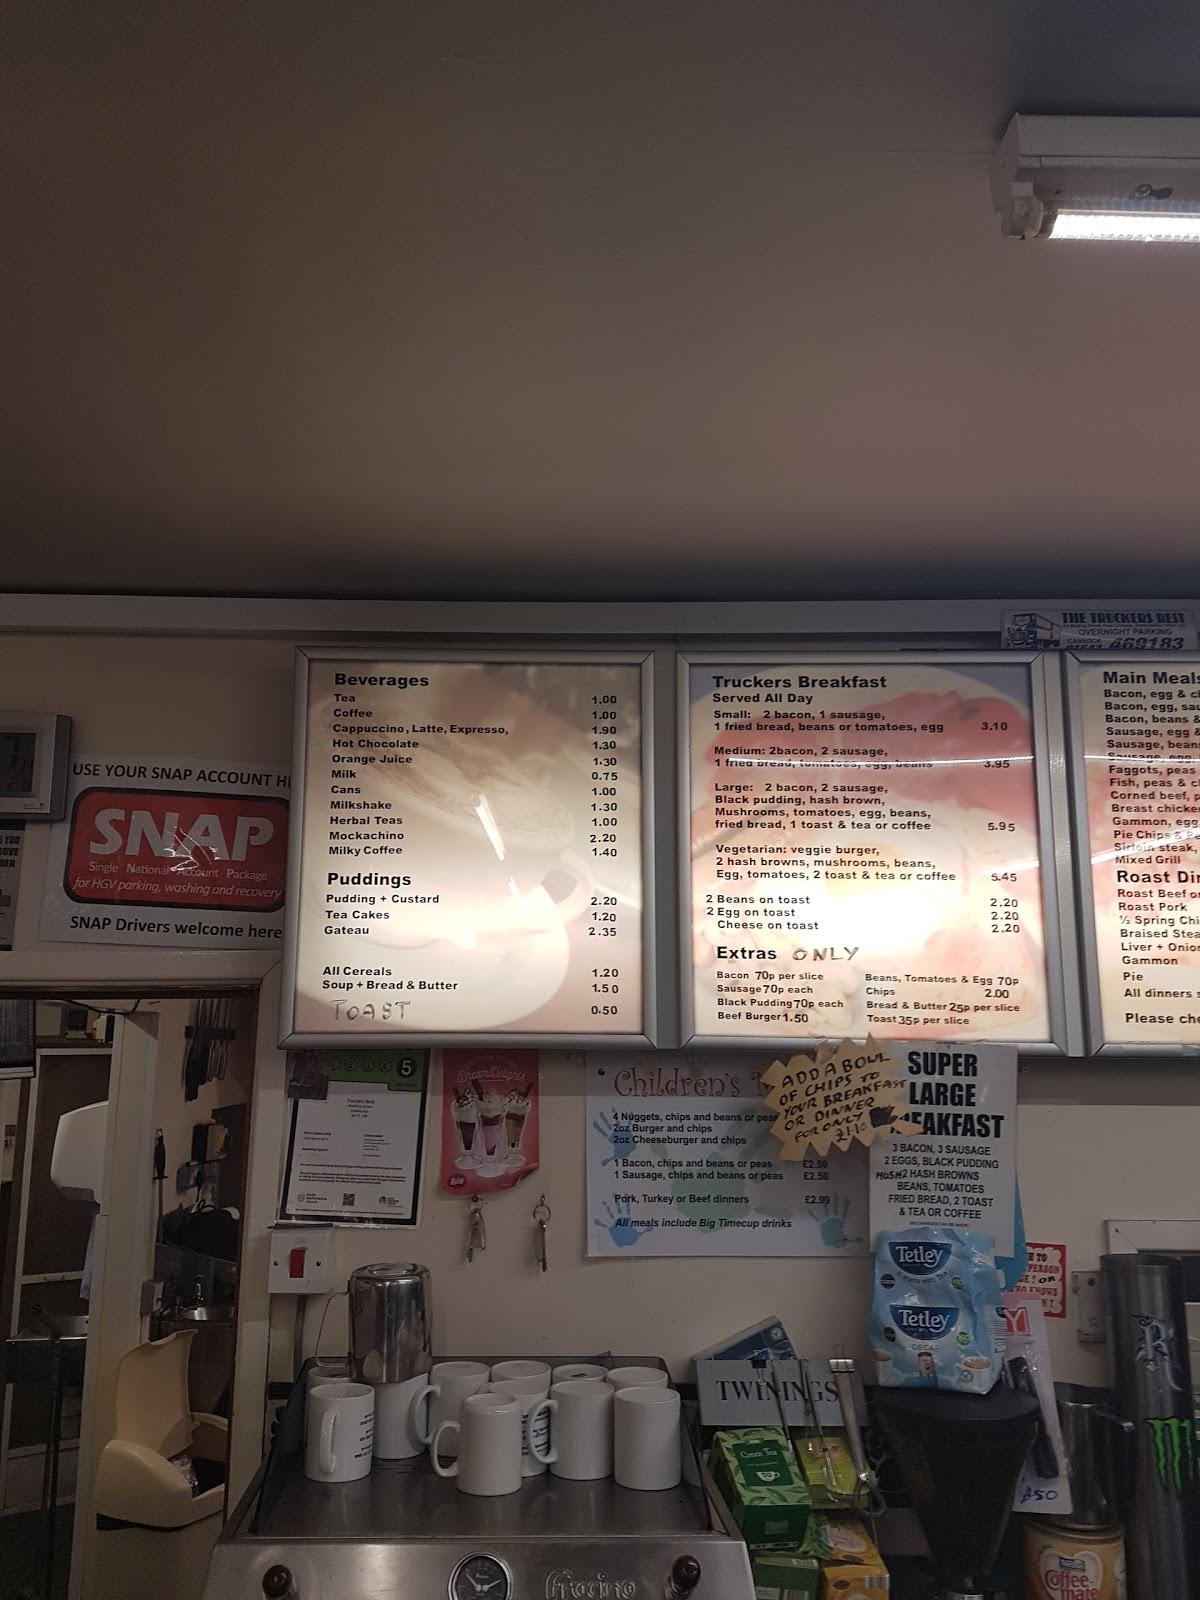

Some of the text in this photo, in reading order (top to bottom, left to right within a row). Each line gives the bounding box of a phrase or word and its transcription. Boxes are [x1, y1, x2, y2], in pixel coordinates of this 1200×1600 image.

[1062, 612, 1086, 624] THE
[1078, 628, 1130, 636] OVERNIGHT
[335, 672, 429, 689] Beverages
[712, 675, 887, 688] Truckers Breakfast
[1103, 671, 1146, 684] Main
[333, 693, 356, 702] Tea
[592, 695, 617, 704] 1.00
[712, 693, 813, 705] Served All Day
[1104, 689, 1186, 700] Bacon, egg &
[333, 708, 373, 718] Coffee
[592, 710, 617, 720] 1.00
[714, 710, 885, 721] Small: 2 bacon, 1 sausage,
[332, 724, 508, 736] Cappuccino, Latte, Expresso,
[591, 725, 617, 735] 1.90
[714, 722, 720, 731] 1
[724, 722, 752, 731] fried
[756, 722, 794, 732] bread,
[798, 722, 835, 731] beans
[855, 722, 917, 733] tomatoes,
[920, 724, 944, 733] egg
[981, 722, 1008, 731] 3.10
[332, 739, 419, 748] Hot Chocolate
[592, 740, 616, 750] 1.30
[332, 754, 412, 766] Orange Juice
[593, 757, 617, 767] 1.30
[72, 762, 273, 786] USE YOUR SNAP ACCOUNT
[331, 769, 357, 778] Milk
[591, 771, 618, 781] 0.75
[1109, 765, 1196, 776] Faggots, peas
[715, 783, 888, 794] Large: 2 bacon, 2 sausage,
[90, 808, 274, 861] SNAP
[329, 831, 404, 840] Mockachino
[590, 833, 616, 843] 2.20
[329, 845, 403, 857] Milky Coffee
[592, 847, 617, 857] 1.40
[715, 844, 880, 856] Vegetarian: veggie burger,
[1115, 855, 1181, 864] Mixed Grill
[328, 872, 411, 889] Puddings
[73, 877, 282, 900] for HGV parking, washing and recovery
[326, 894, 376, 906] Pudding
[391, 894, 440, 904] Custard
[590, 896, 617, 906] 2.20
[706, 894, 713, 903] 2
[717, 894, 755, 904] Beans
[778, 896, 810, 904] toast
[990, 898, 1018, 908] 2.20
[1118, 902, 1188, 912] Roast Pork
[325, 910, 390, 919] Tea Cakes
[592, 912, 616, 922] 1.20
[70, 916, 283, 938] SNAP Drivers welcome here
[324, 925, 369, 935] Gateau
[588, 926, 617, 937] 2.35
[717, 946, 777, 960] Extras
[792, 946, 859, 962] ONLY
[1122, 955, 1178, 965] Gammon
[322, 966, 392, 976] All Cereals
[592, 968, 619, 978] 1.20
[716, 971, 749, 979] Bacon
[754, 970, 775, 981] 70p
[798, 972, 824, 980] slice
[322, 980, 354, 992] Soup
[366, 980, 404, 990] Bread
[406, 980, 415, 990] &
[418, 980, 458, 990] Butter
[592, 983, 619, 994] 1.50
[327, 999, 411, 1022] TOAST
[591, 1005, 618, 1016] 0.50
[718, 1012, 808, 1023] Beef Burger 1.50
[401, 1060, 412, 1075] 5
[908, 1051, 978, 1077] SUPER
[782, 1053, 891, 1088] ADD A BOWL
[614, 1065, 740, 1098] Children's
[909, 1082, 976, 1107] LARGE
[613, 1122, 713, 1135] 2oz Burger and chips
[613, 1135, 747, 1146] 2oz Cheeseburger and chips
[892, 1143, 991, 1156] 3 BACON, 3 SAUSAGE
[897, 1181, 984, 1194] BEANS, TOMATOES
[805, 1195, 831, 1205] £2.99
[614, 1217, 792, 1230] All meals include Big Timecup drinks
[896, 1246, 944, 1267] Tetley
[898, 1310, 950, 1332] Tetley
[716, 1380, 840, 1402] TWININGS
[1045, 1569, 1088, 1590] Coffee
